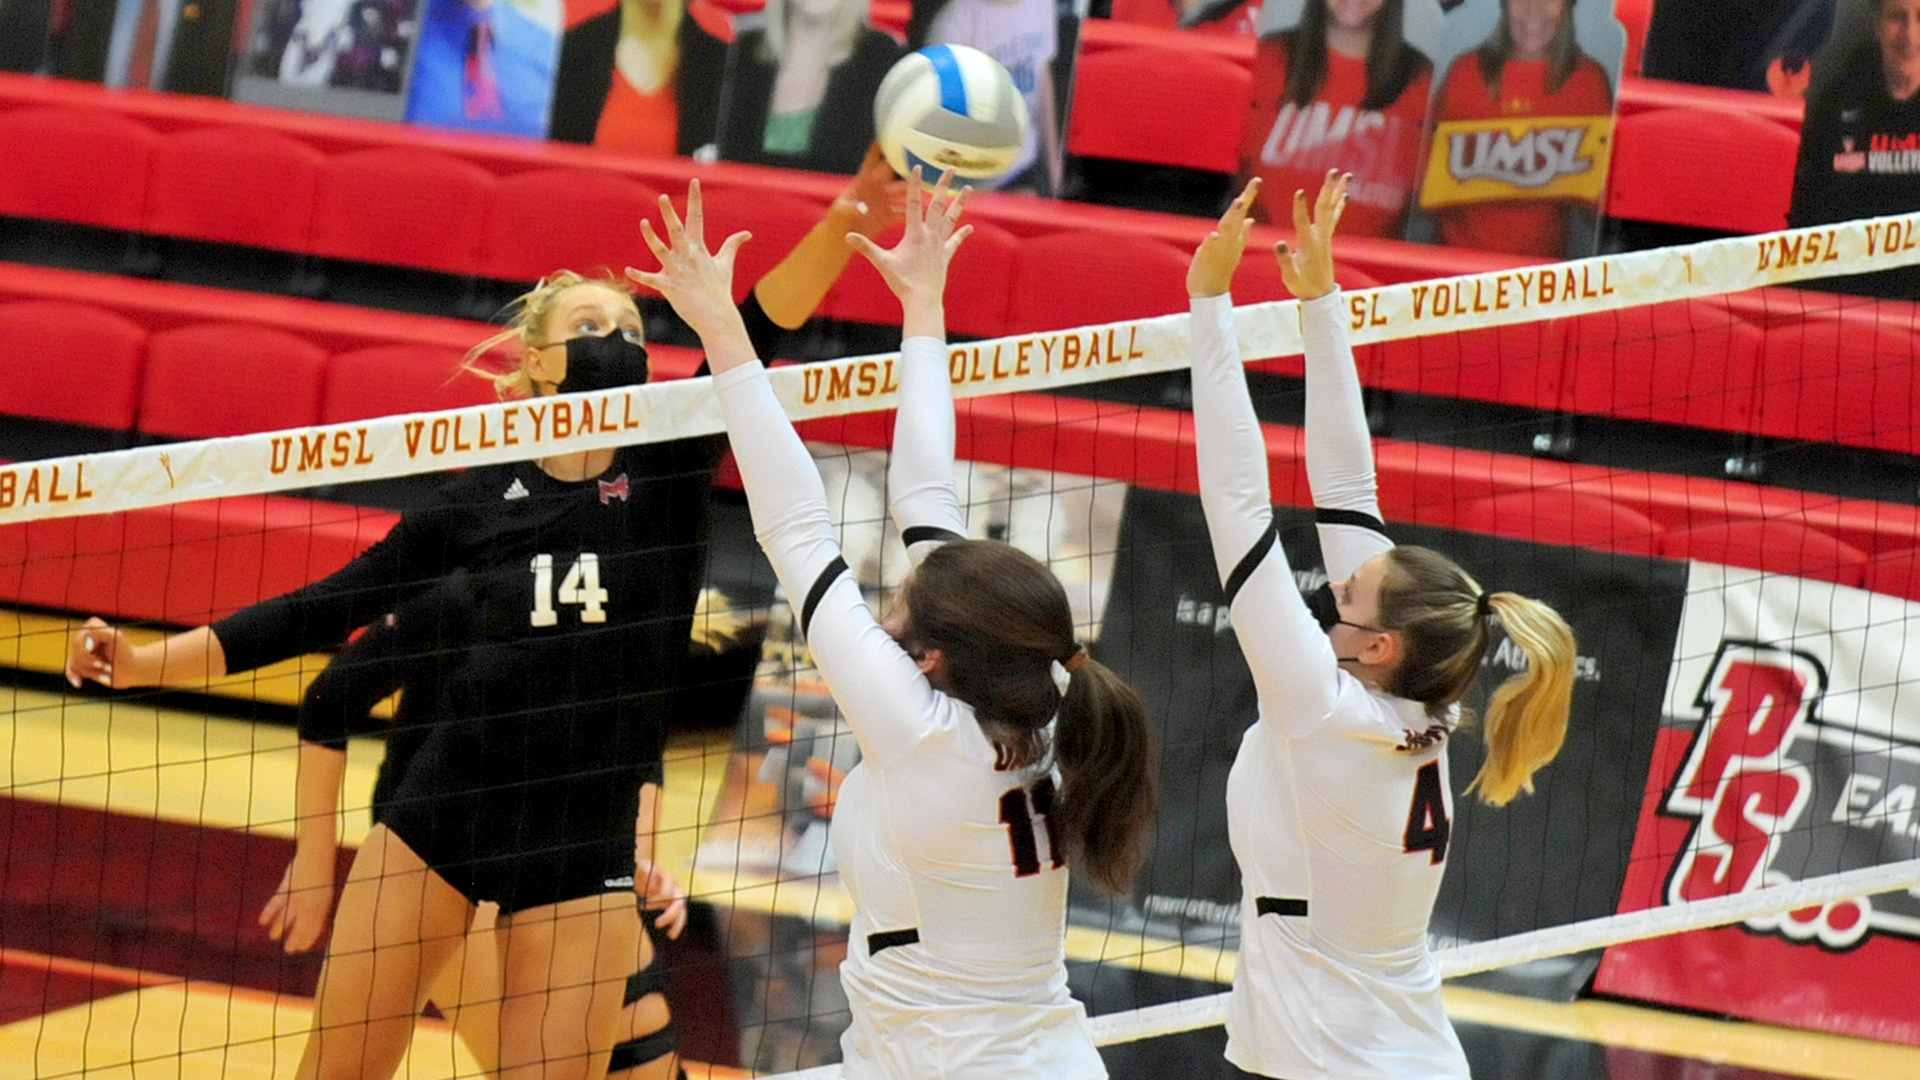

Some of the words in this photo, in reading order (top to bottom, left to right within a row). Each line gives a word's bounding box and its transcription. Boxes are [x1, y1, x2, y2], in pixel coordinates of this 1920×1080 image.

[1449, 128, 1592, 188] UMSL
[1757, 230, 1839, 272] UMSL
[1411, 261, 1615, 321] VOLLEYBALL
[802, 360, 899, 405] UMSL
[950, 325, 1144, 385] OLLEYBALL
[269, 427, 374, 475] UMSL
[403, 392, 640, 459] VOLLEYBALL
[0, 460, 93, 509] BALL
[530, 552, 609, 627] 14
[998, 772, 1068, 879] 11
[1402, 757, 1451, 866] 4
[1831, 773, 1920, 838] EA
